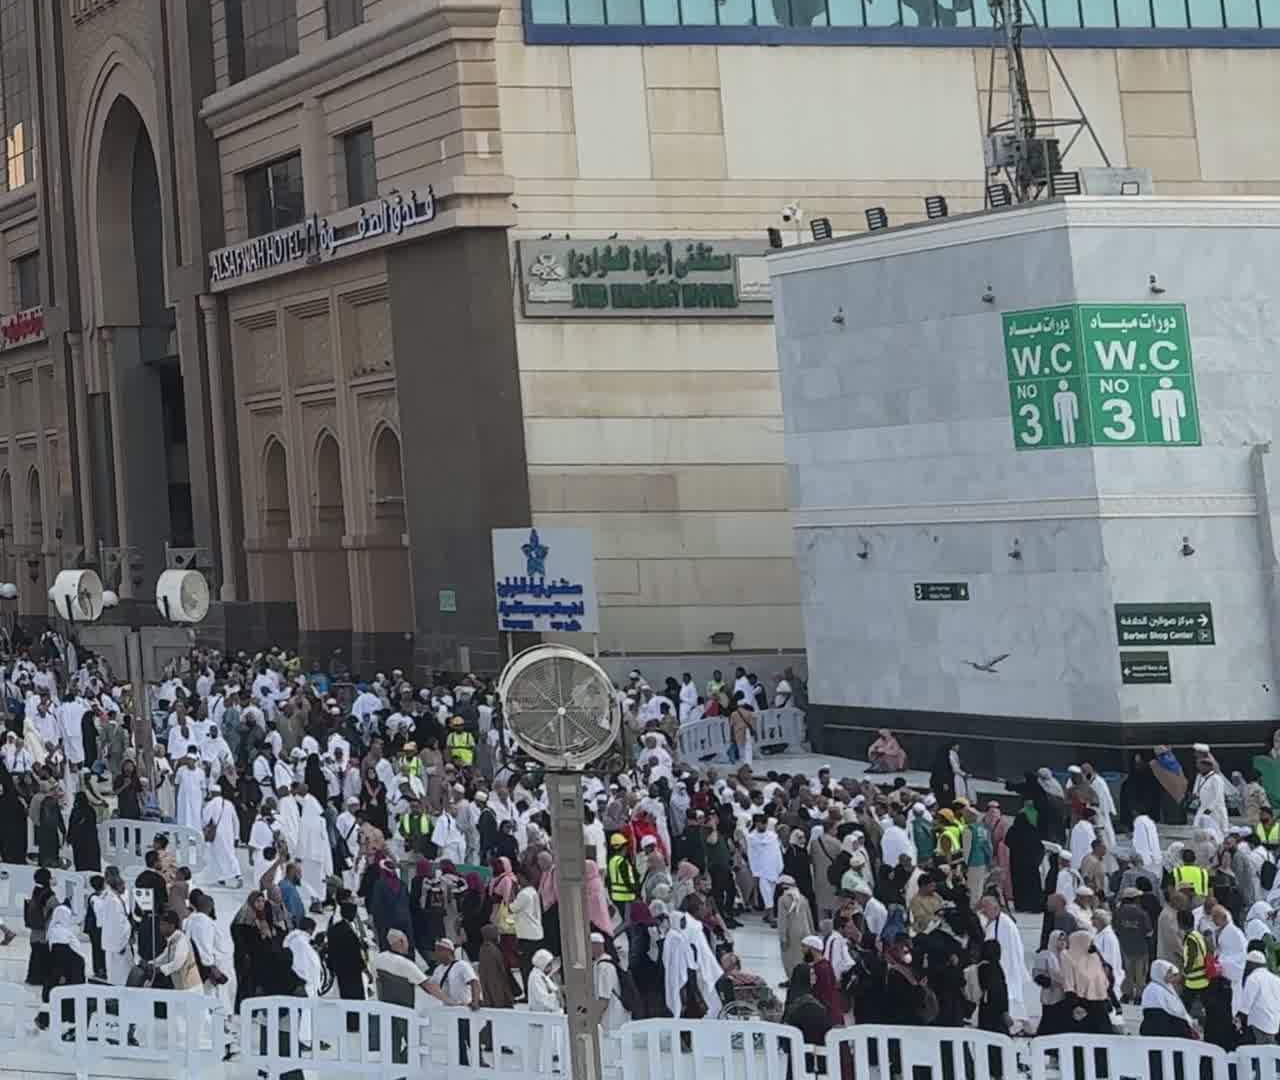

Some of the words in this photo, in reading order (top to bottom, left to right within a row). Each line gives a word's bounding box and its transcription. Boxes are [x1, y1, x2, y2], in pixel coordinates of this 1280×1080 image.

[1043, 316, 1070, 336] دورات
[1140, 313, 1177, 334] دورات
[1011, 342, 1073, 377] W.C
[1093, 340, 1180, 371] W.C
[1017, 383, 1038, 400] NO
[1100, 378, 1130, 394] NO
[1019, 403, 1044, 445] 3
[1102, 398, 1136, 441] 3
[1123, 631, 1148, 640] Barber
[1149, 631, 1169, 641] Shop
[1169, 631, 1194, 640] Center
